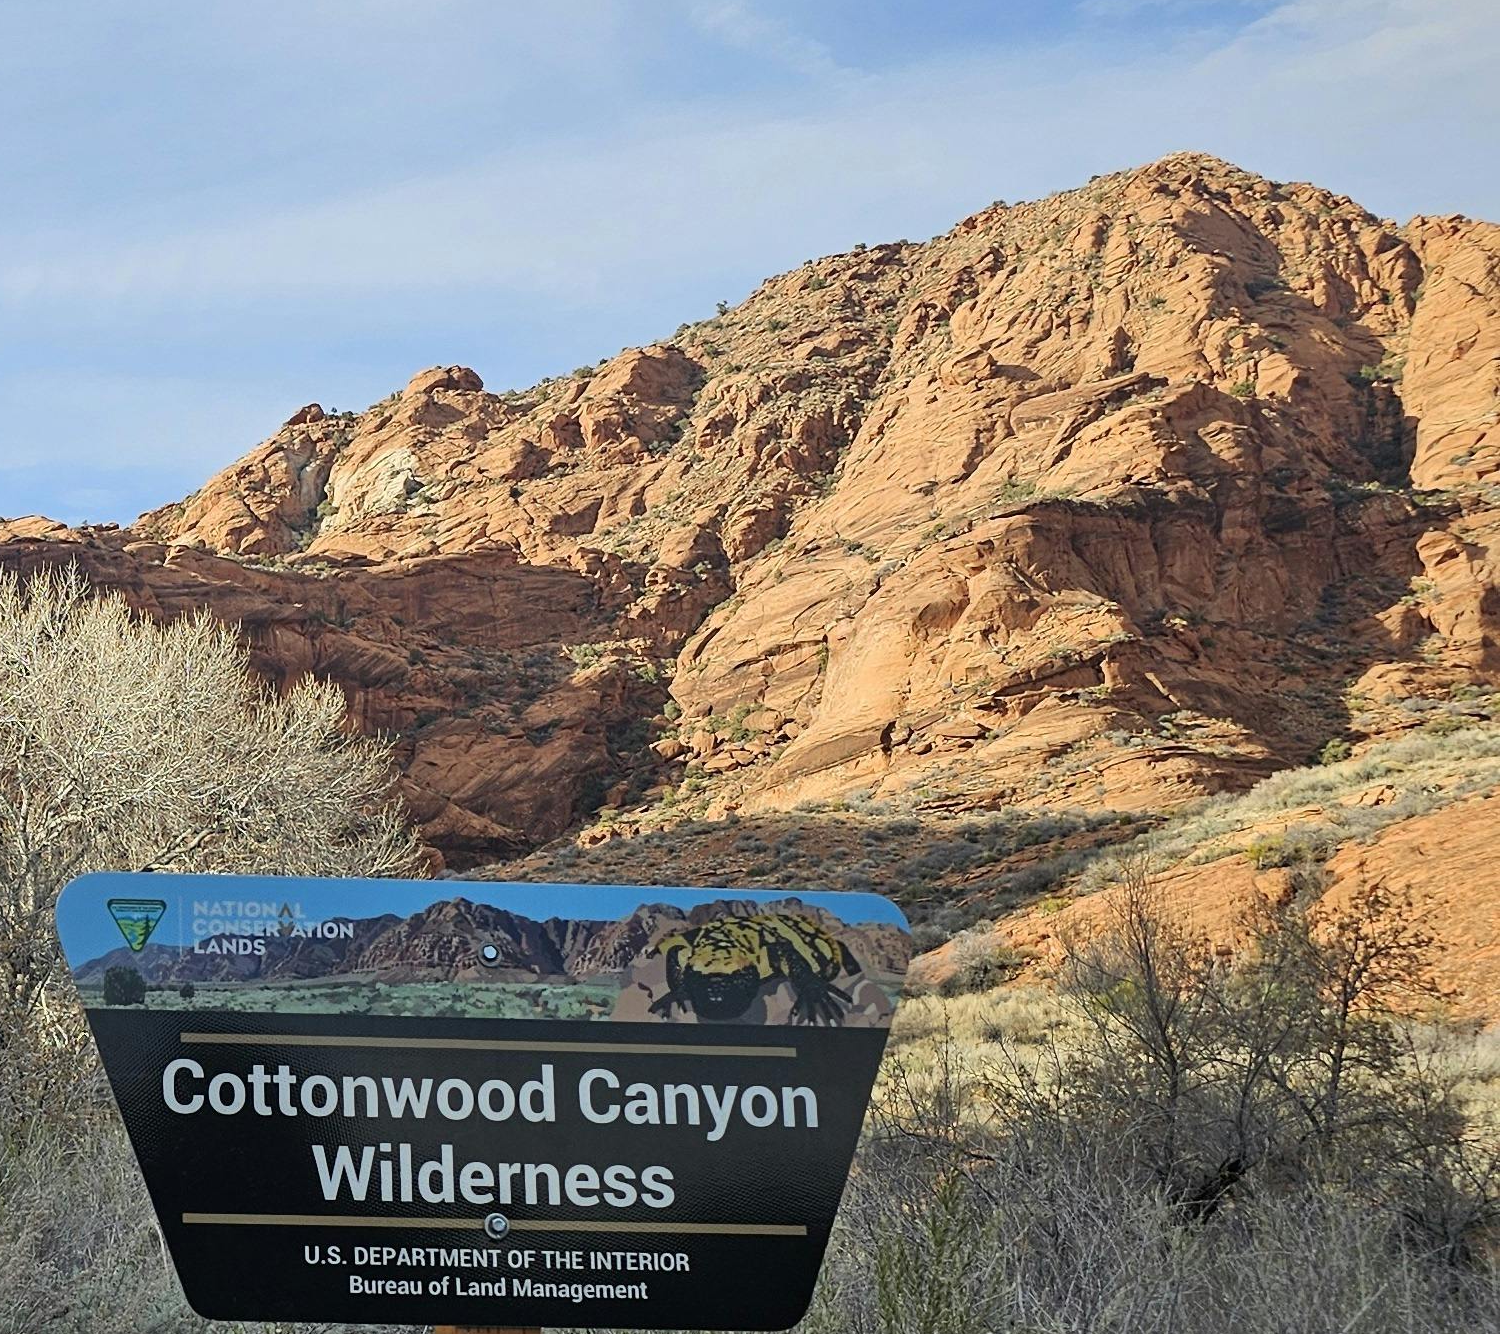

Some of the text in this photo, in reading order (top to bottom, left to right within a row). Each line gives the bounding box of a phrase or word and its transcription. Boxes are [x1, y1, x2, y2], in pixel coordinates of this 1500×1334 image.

[193, 900, 305, 918] NATIONAL
[193, 938, 266, 956] LANDS
[162, 1058, 819, 1142] Cottonwood Canyon
[311, 1142, 675, 1208] Wilderness
[304, 1245, 690, 1272] U.S. DEPARTMENT OF THE INTERIOR
[349, 1275, 648, 1303] Bureau of Land Management
